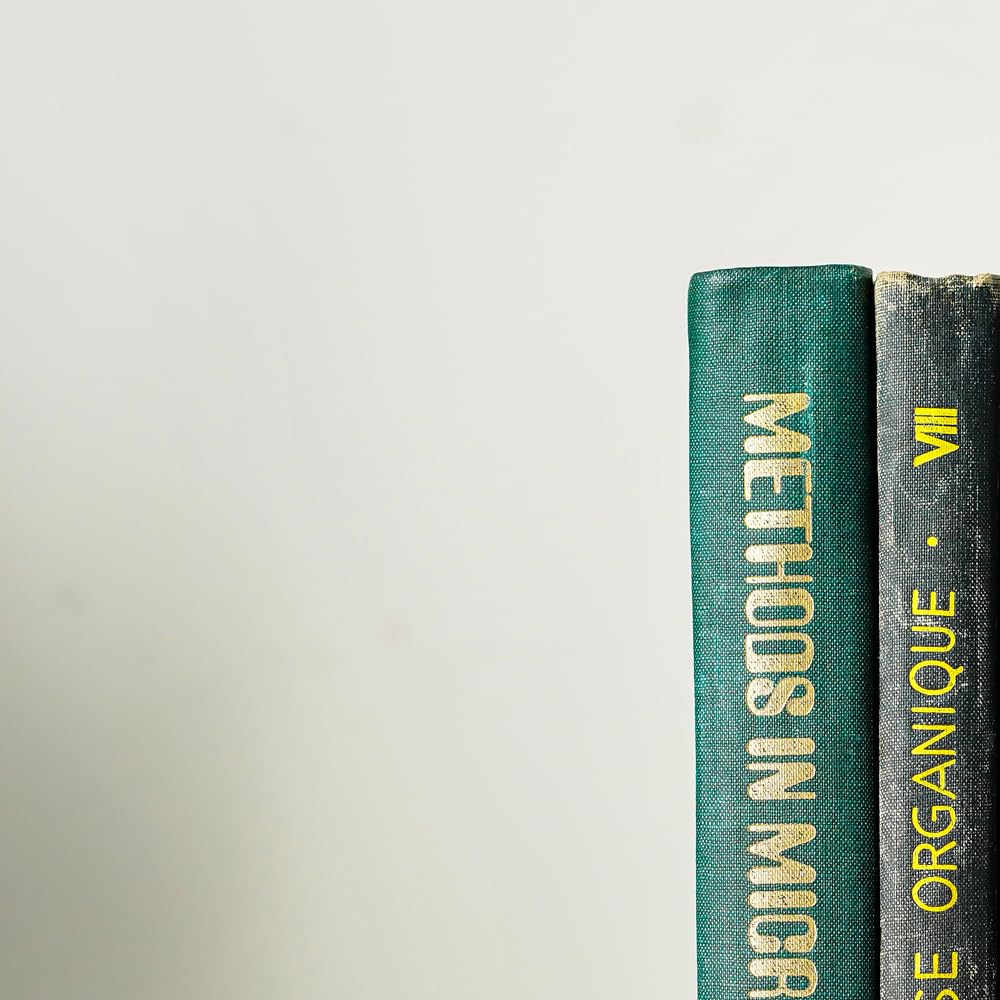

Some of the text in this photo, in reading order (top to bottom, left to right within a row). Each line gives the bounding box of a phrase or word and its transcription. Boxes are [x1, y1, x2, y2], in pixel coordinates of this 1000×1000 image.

[912, 407, 959, 467] VIII
[743, 392, 816, 717] METHODS
[744, 737, 816, 802] IN
[908, 590, 959, 913] ORGANIQUE
